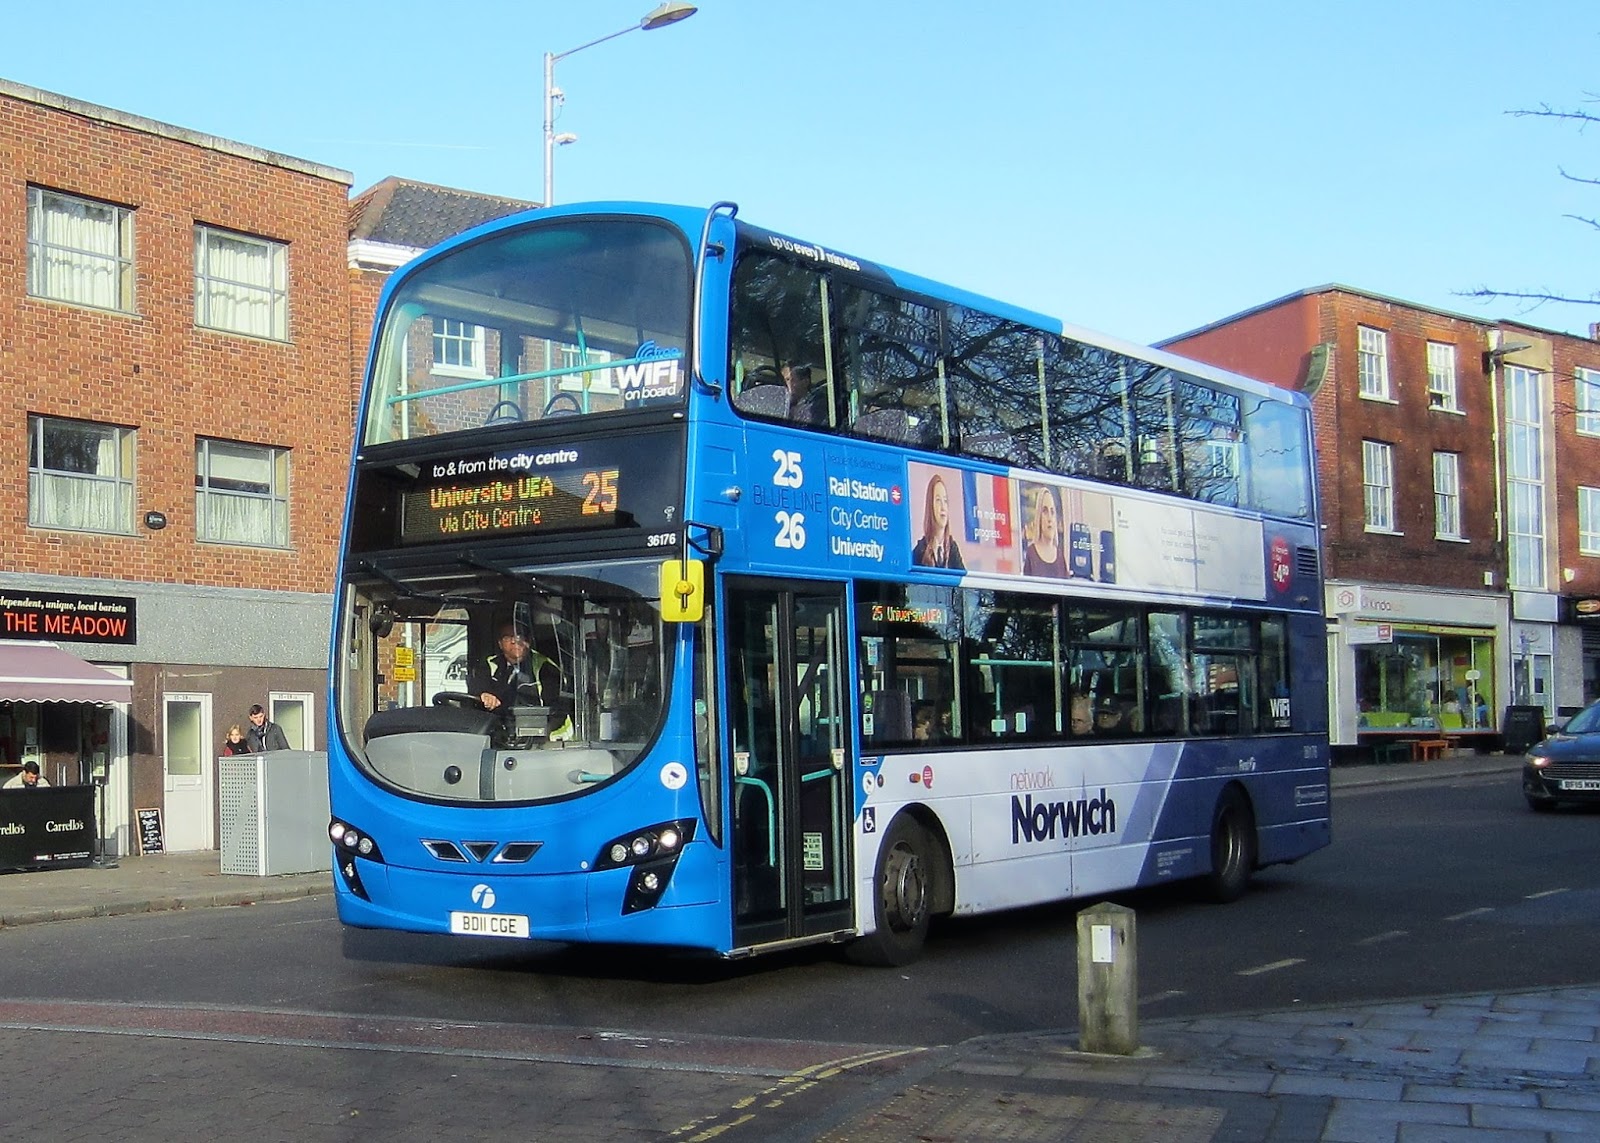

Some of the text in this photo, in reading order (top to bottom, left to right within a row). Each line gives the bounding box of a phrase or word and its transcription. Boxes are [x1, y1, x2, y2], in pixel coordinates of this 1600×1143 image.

[768, 235, 860, 272] up to every 7 minutes
[624, 383, 677, 401] on board
[433, 449, 579, 478] to & from the city centre
[772, 449, 804, 489] 25
[430, 475, 554, 509] University UEA
[581, 470, 620, 516] 25
[753, 485, 823, 514] BLUE LINE
[829, 476, 889, 503] Rail Station
[439, 505, 542, 533] via City Centre
[774, 510, 806, 550] 26
[830, 505, 889, 532] City Centre
[647, 533, 677, 548] 36176
[831, 535, 885, 562] University
[45, 600, 77, 613] unique,
[77, 600, 97, 612] local
[98, 602, 127, 613] barista
[872, 605, 883, 621] 25
[4, 612, 127, 637] THE MEADOW
[1010, 765, 1055, 790] network
[45, 819, 85, 833] Carrello's
[1011, 787, 1116, 845] Norwich
[463, 916, 517, 934] BD11 CGE
